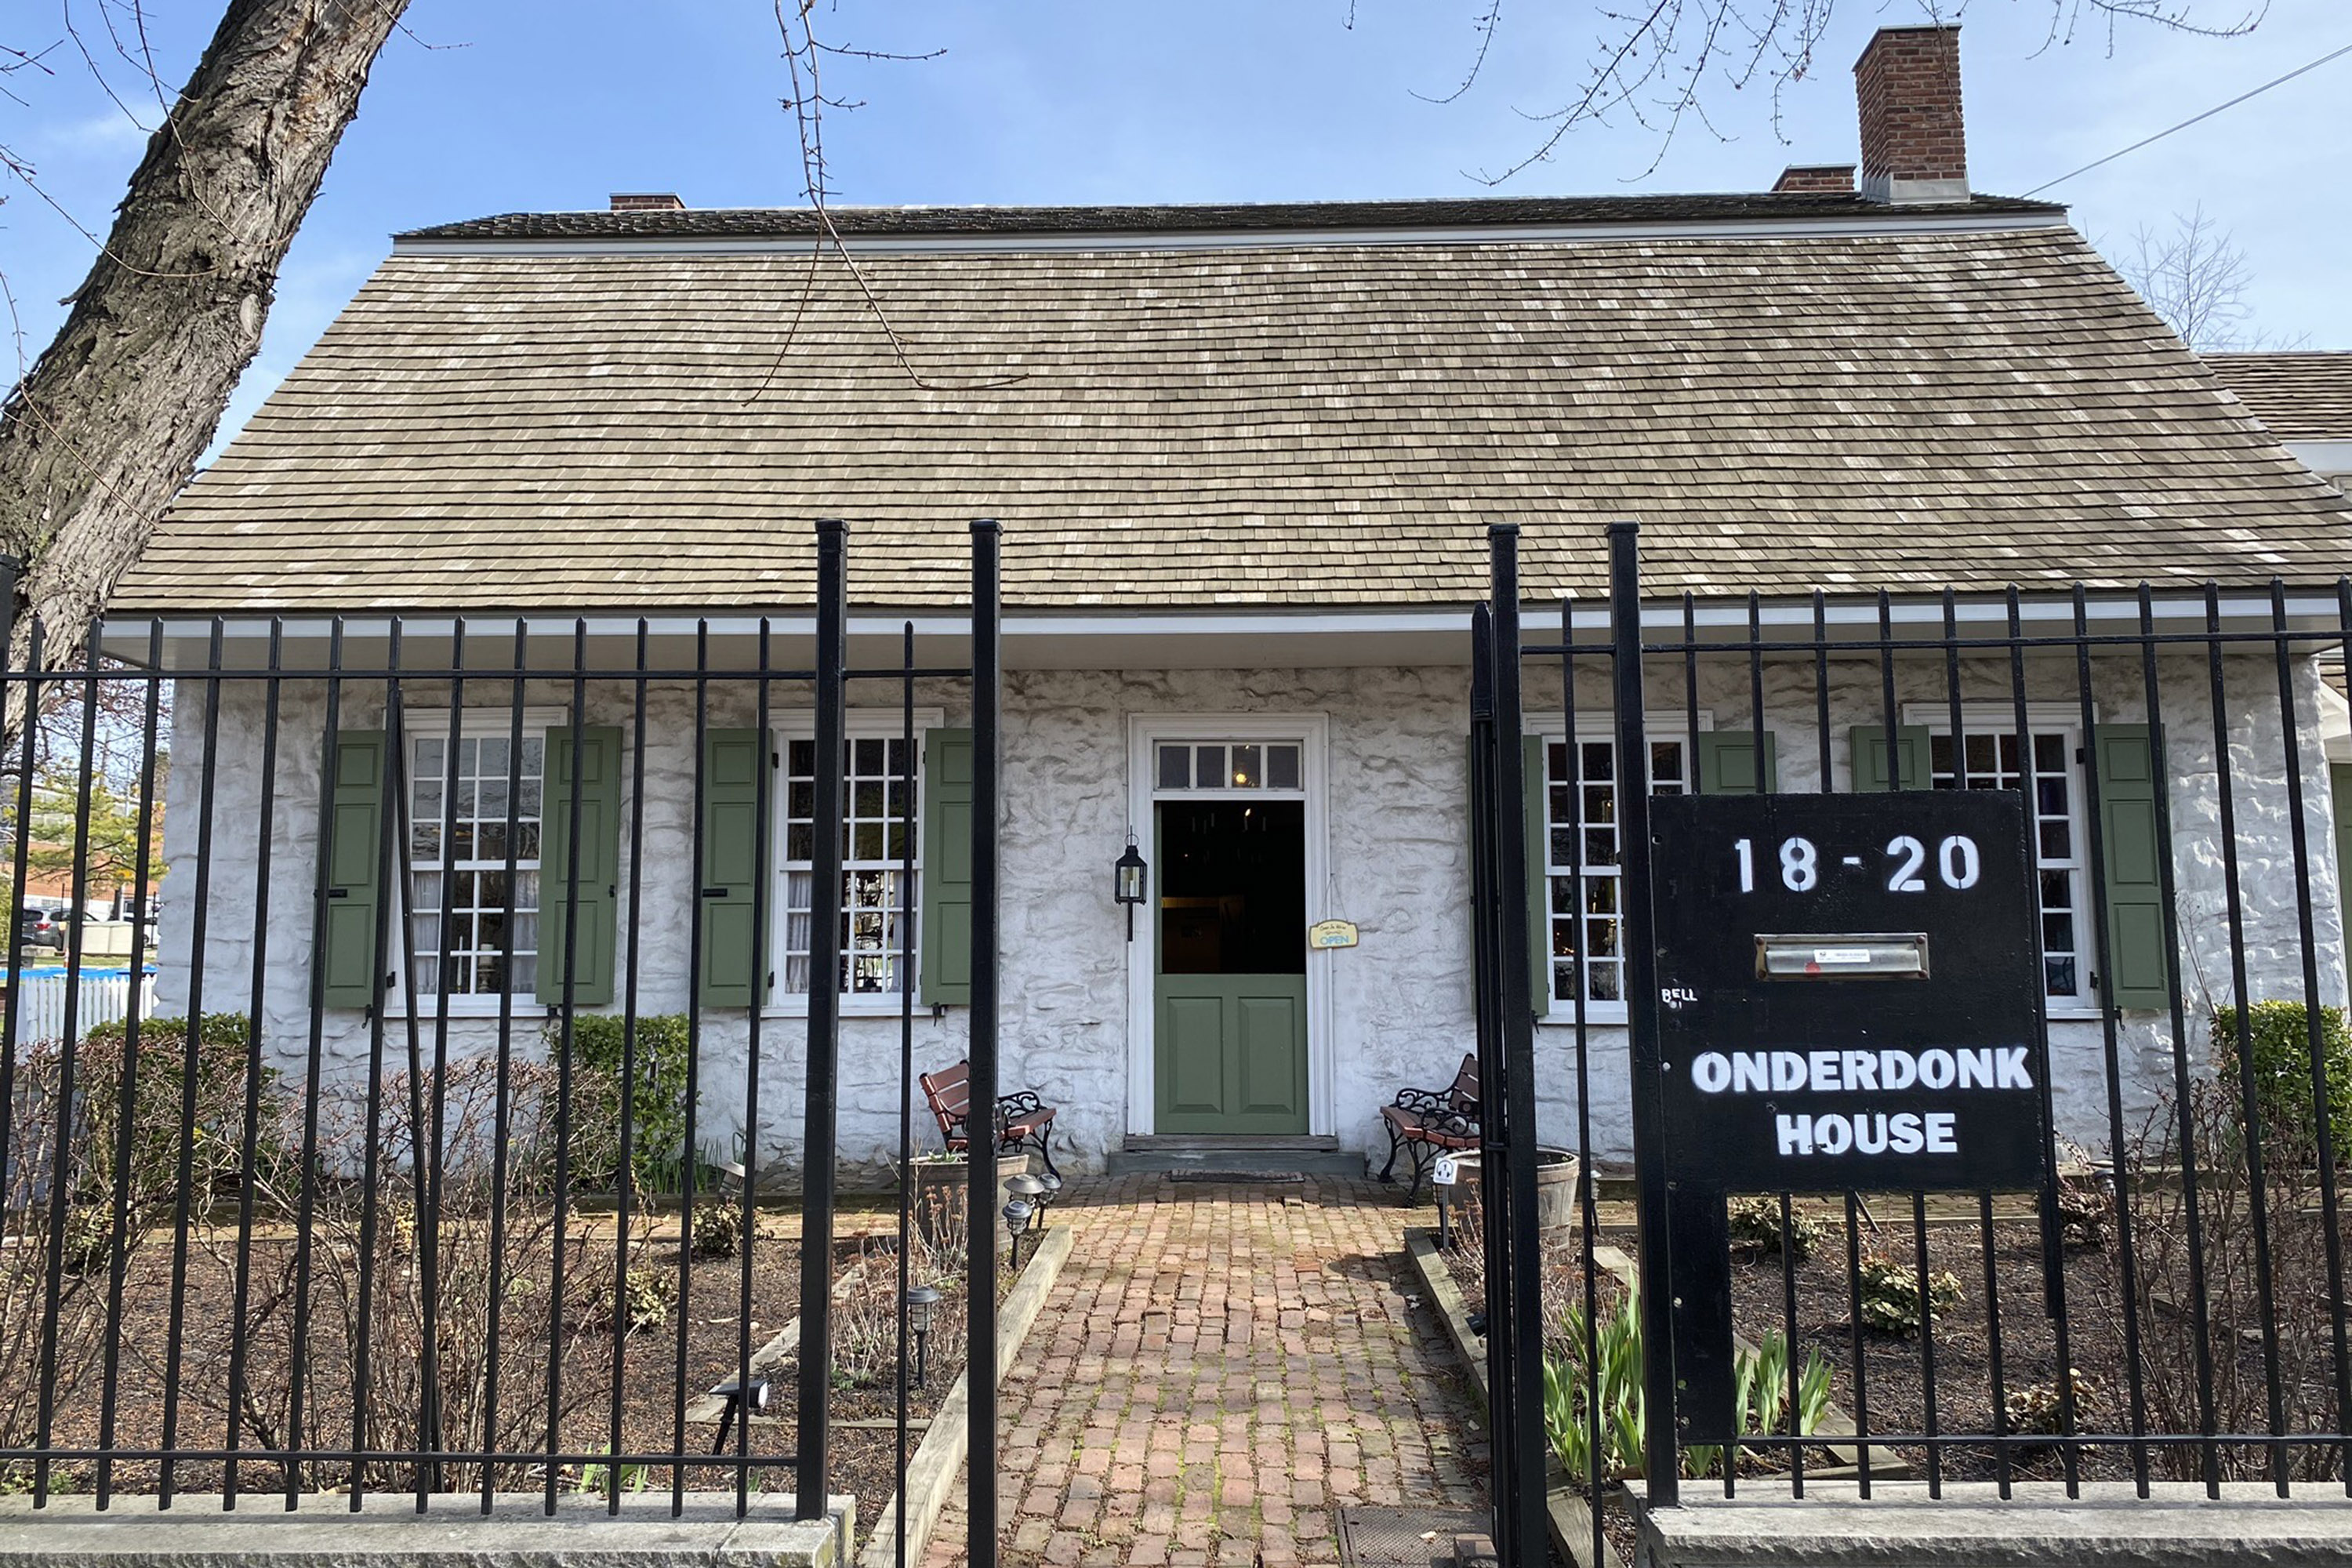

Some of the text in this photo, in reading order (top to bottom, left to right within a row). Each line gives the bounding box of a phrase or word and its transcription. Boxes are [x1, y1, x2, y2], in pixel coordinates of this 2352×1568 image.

[1734, 835, 1980, 893] 18-20
[1319, 935, 1349, 945] OPEN
[1661, 988, 1698, 1004] BELL
[1691, 1047, 2034, 1093] ONDERDONK
[1776, 1112, 1958, 1156] HOUSE
